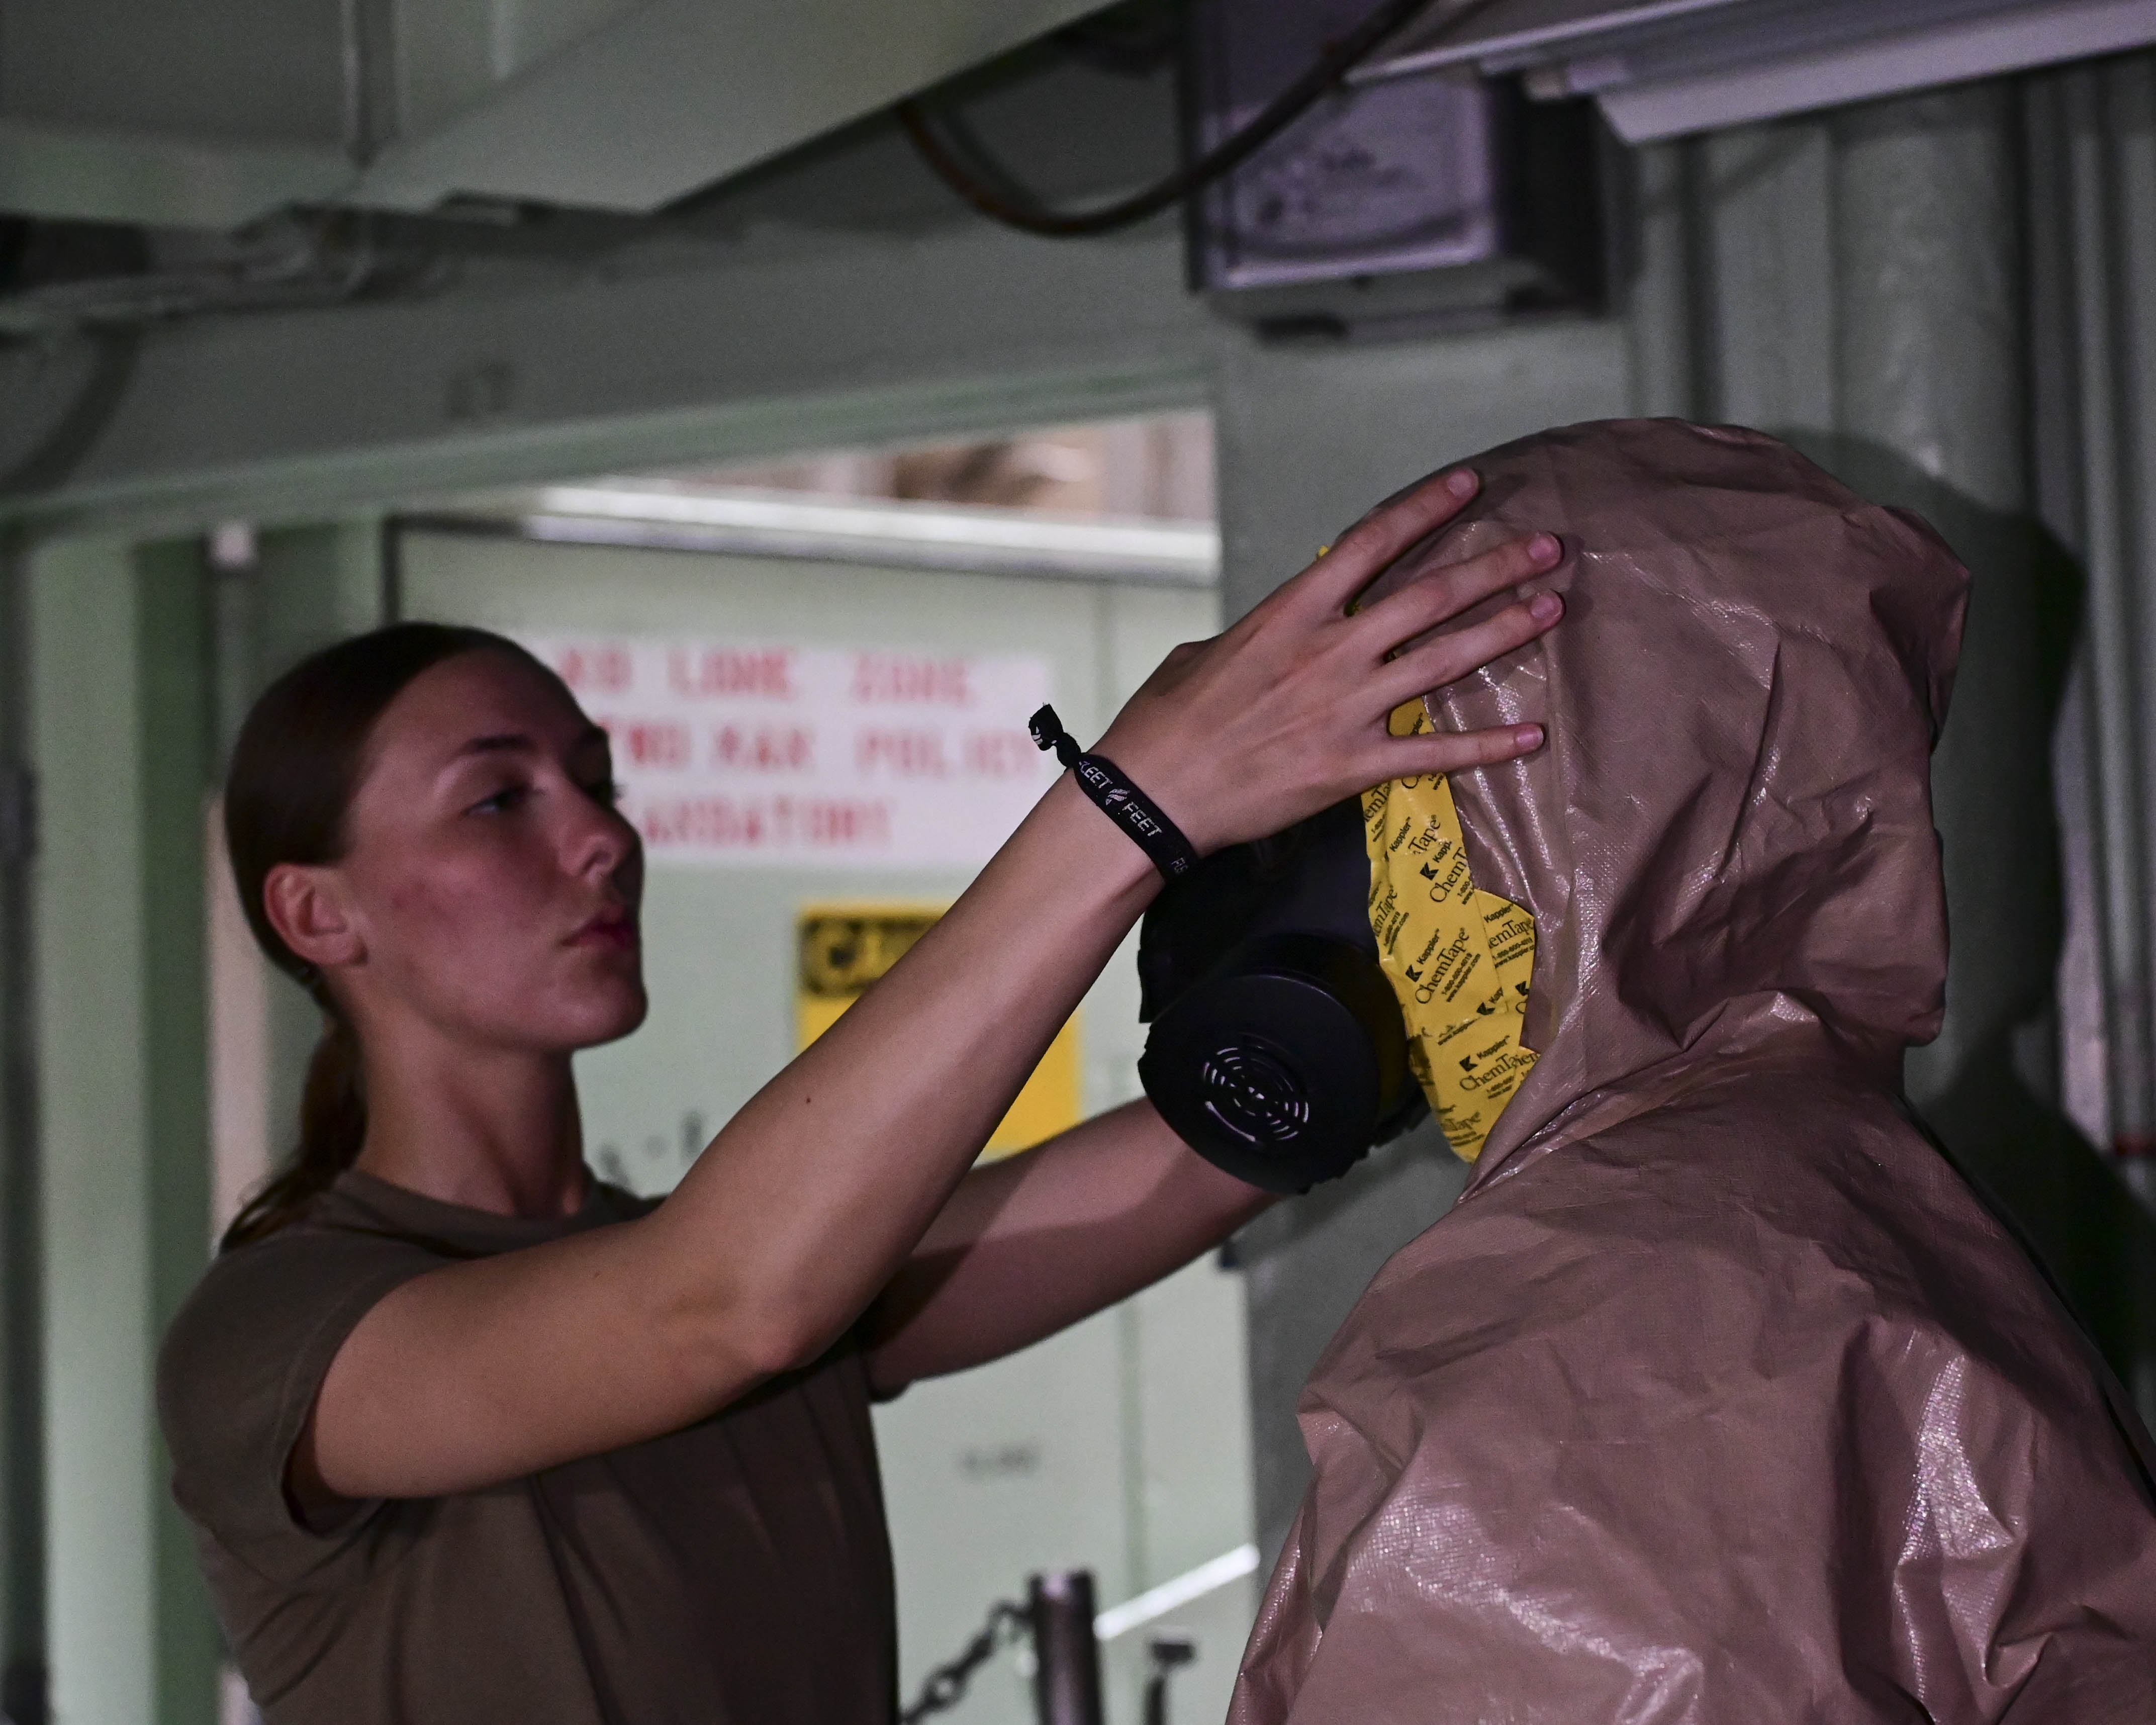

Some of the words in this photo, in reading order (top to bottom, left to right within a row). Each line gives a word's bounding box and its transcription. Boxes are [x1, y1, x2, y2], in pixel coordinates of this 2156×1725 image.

[626, 793, 891, 846] ANDATORY
[1122, 801, 1162, 837] FEET
[1430, 847, 1468, 902] ChemT
[1460, 1053, 1518, 1091] ChemTa
